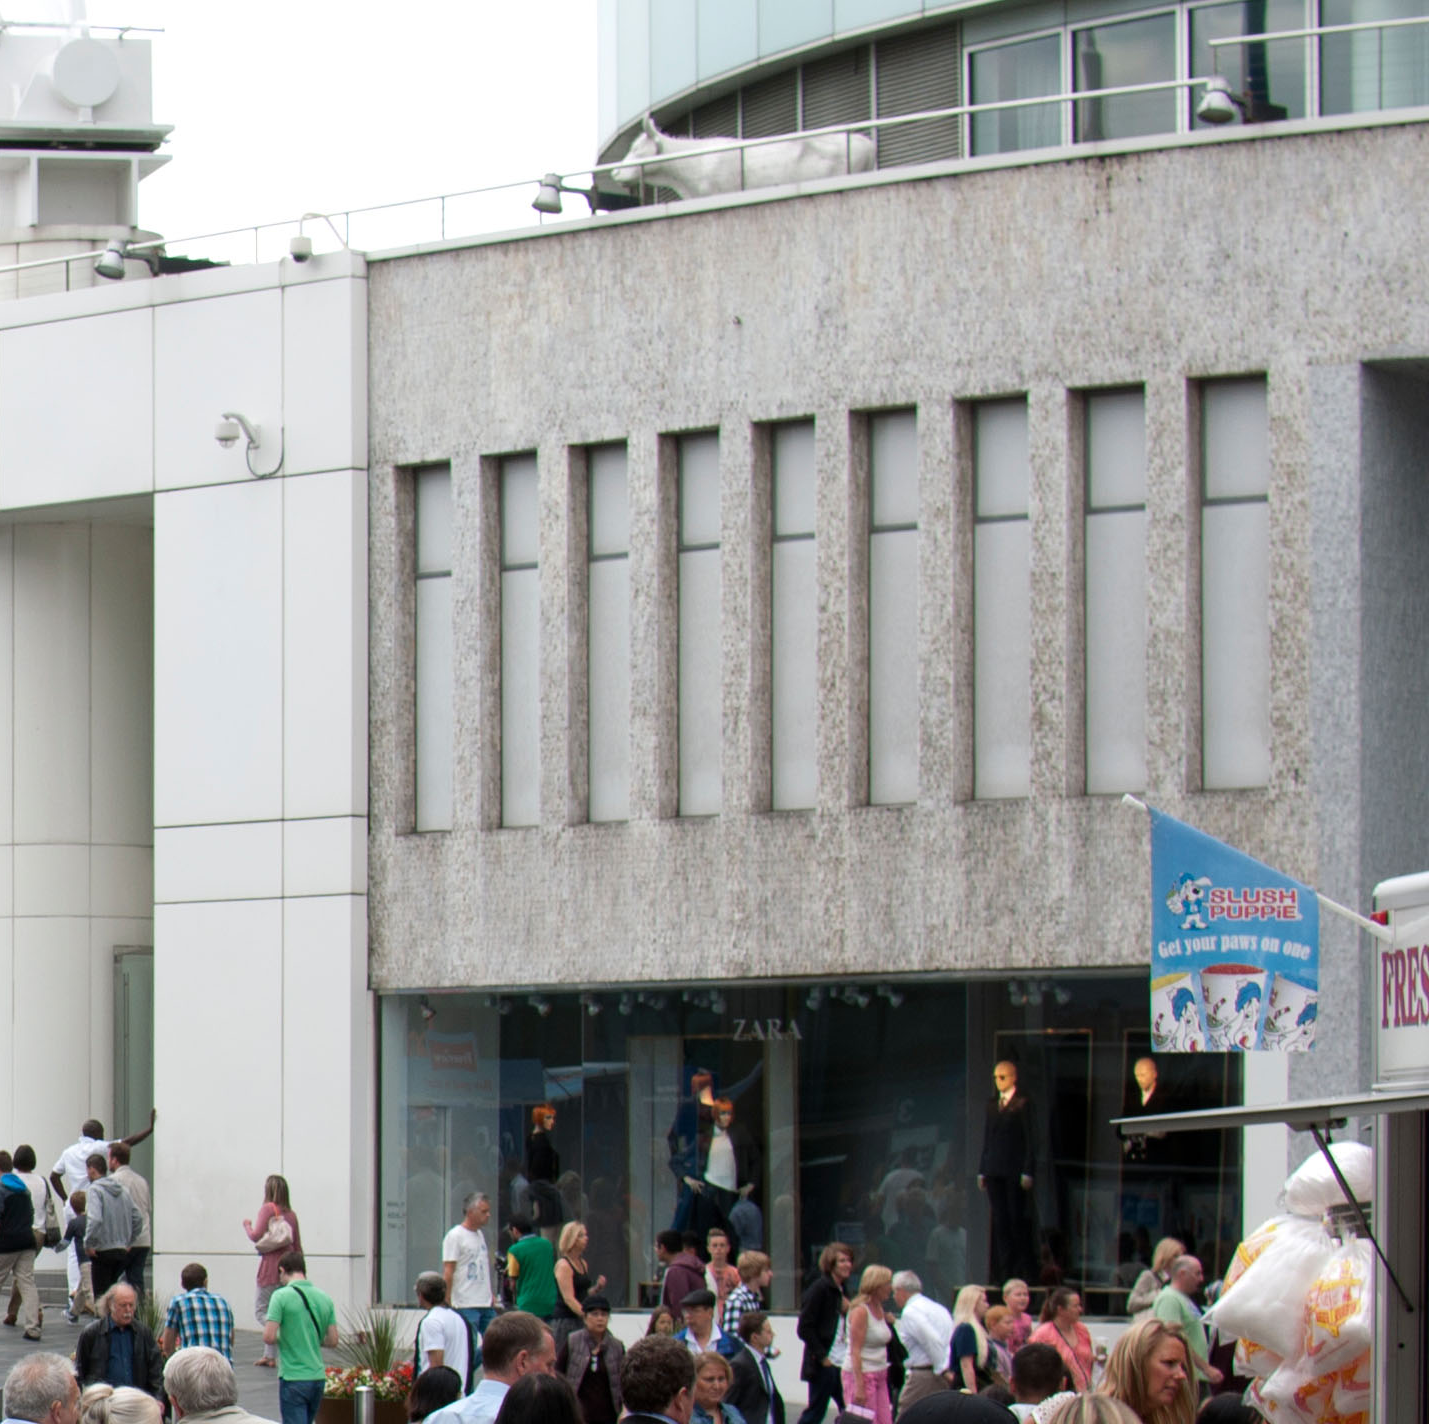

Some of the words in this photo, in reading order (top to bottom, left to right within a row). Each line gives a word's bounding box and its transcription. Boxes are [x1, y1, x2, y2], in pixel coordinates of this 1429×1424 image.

[1209, 887, 1298, 904] SLUSH
[1158, 938, 1182, 959] Get
[1185, 935, 1218, 956] your
[1221, 934, 1258, 953] paws
[1261, 936, 1281, 951] on
[1283, 940, 1311, 961] one
[733, 1018, 803, 1041] ZARA
